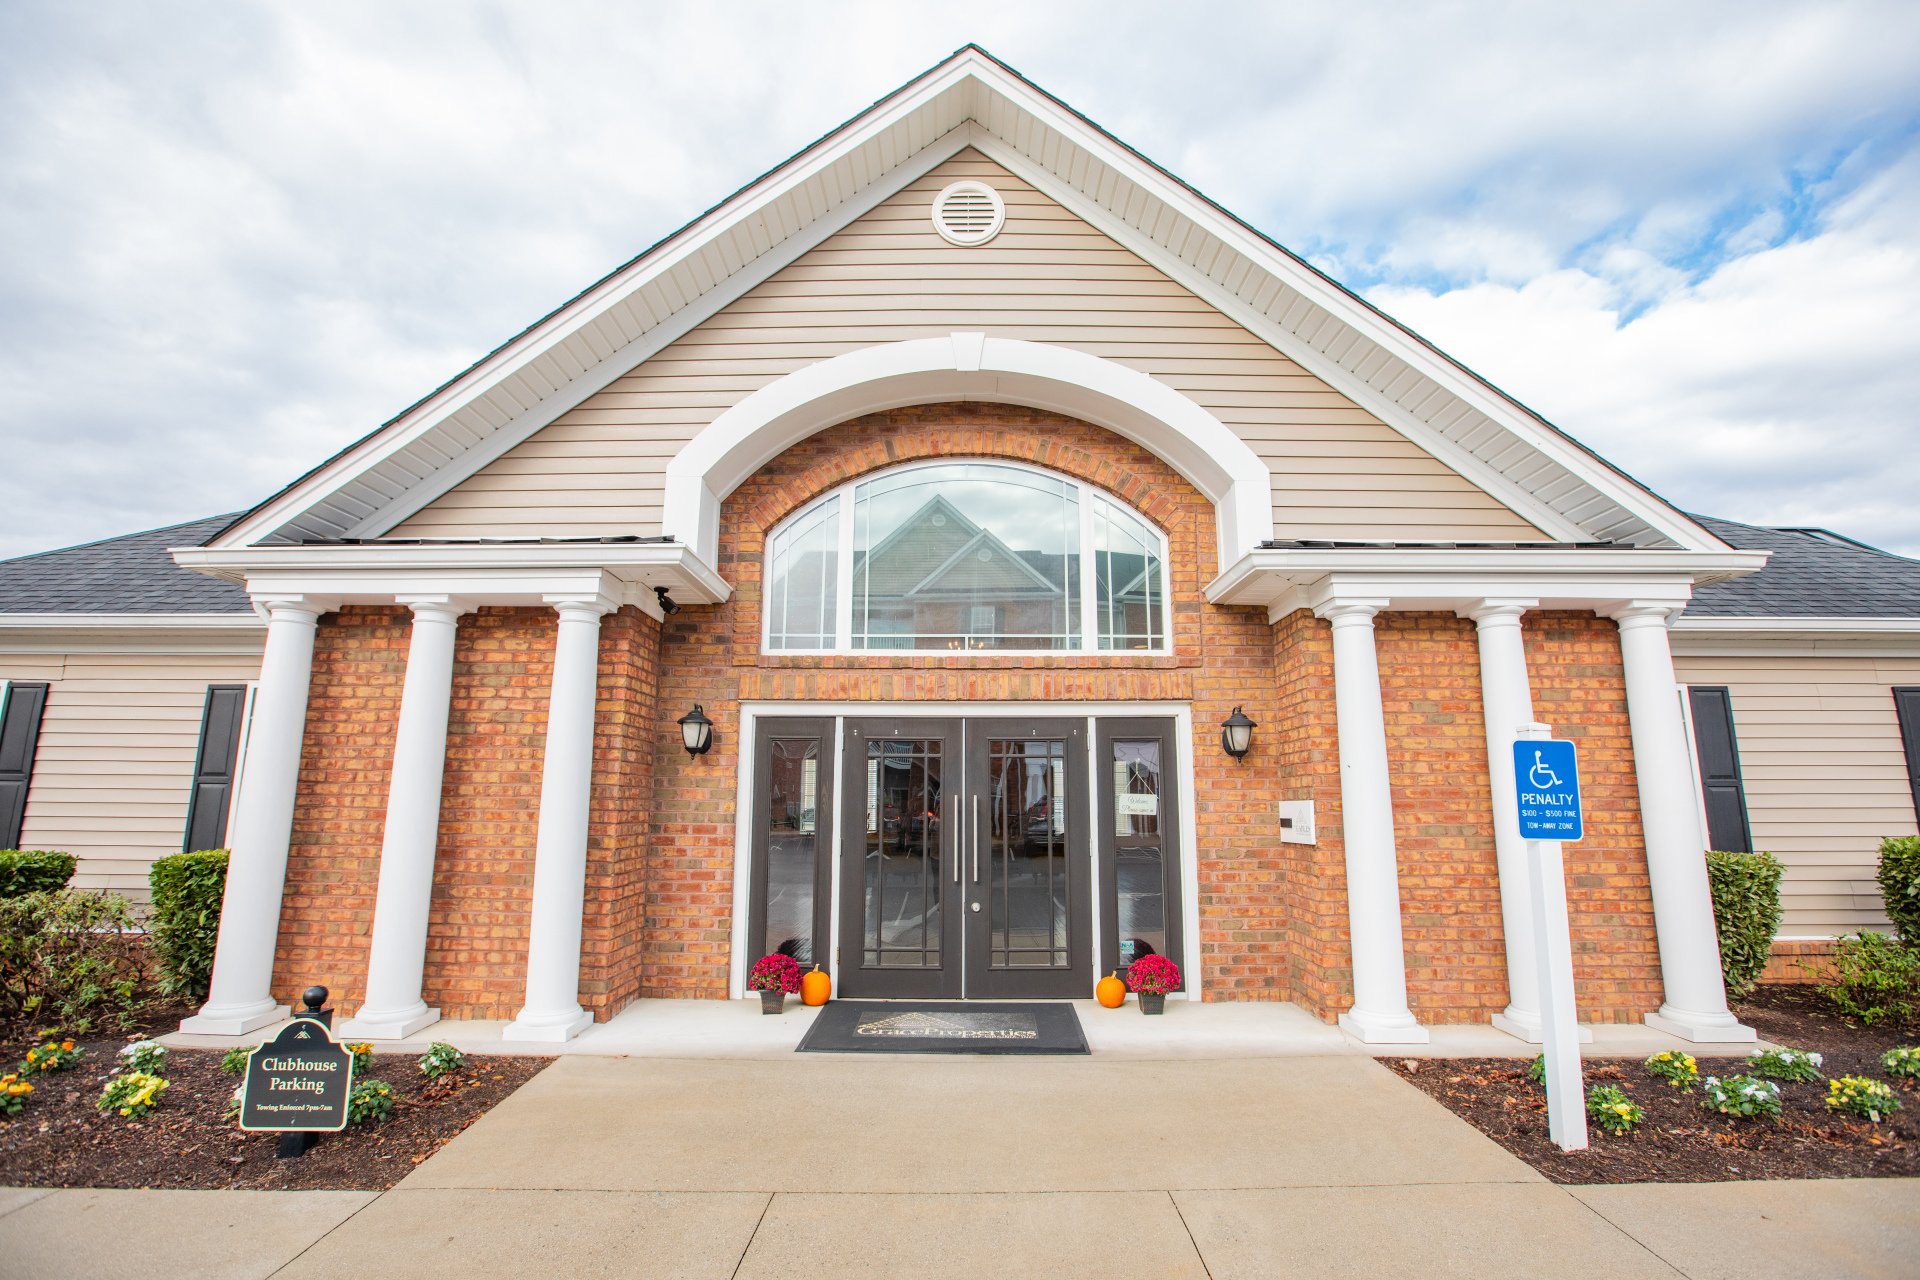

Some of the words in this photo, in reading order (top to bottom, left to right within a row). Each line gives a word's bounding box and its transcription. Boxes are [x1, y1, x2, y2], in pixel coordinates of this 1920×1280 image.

[1521, 793, 1574, 806] PENALTY
[1521, 809, 1537, 817] $100
[1545, 809, 1563, 817] $500
[1563, 810, 1577, 818] FINE
[1526, 822, 1556, 830] TOW-AWAY
[1558, 822, 1574, 830] ZONE
[924, 1027, 1037, 1038] Properties
[261, 1057, 338, 1072] Clubhouse
[269, 1077, 326, 1095] Parking
[256, 1104, 279, 1112] Towing
